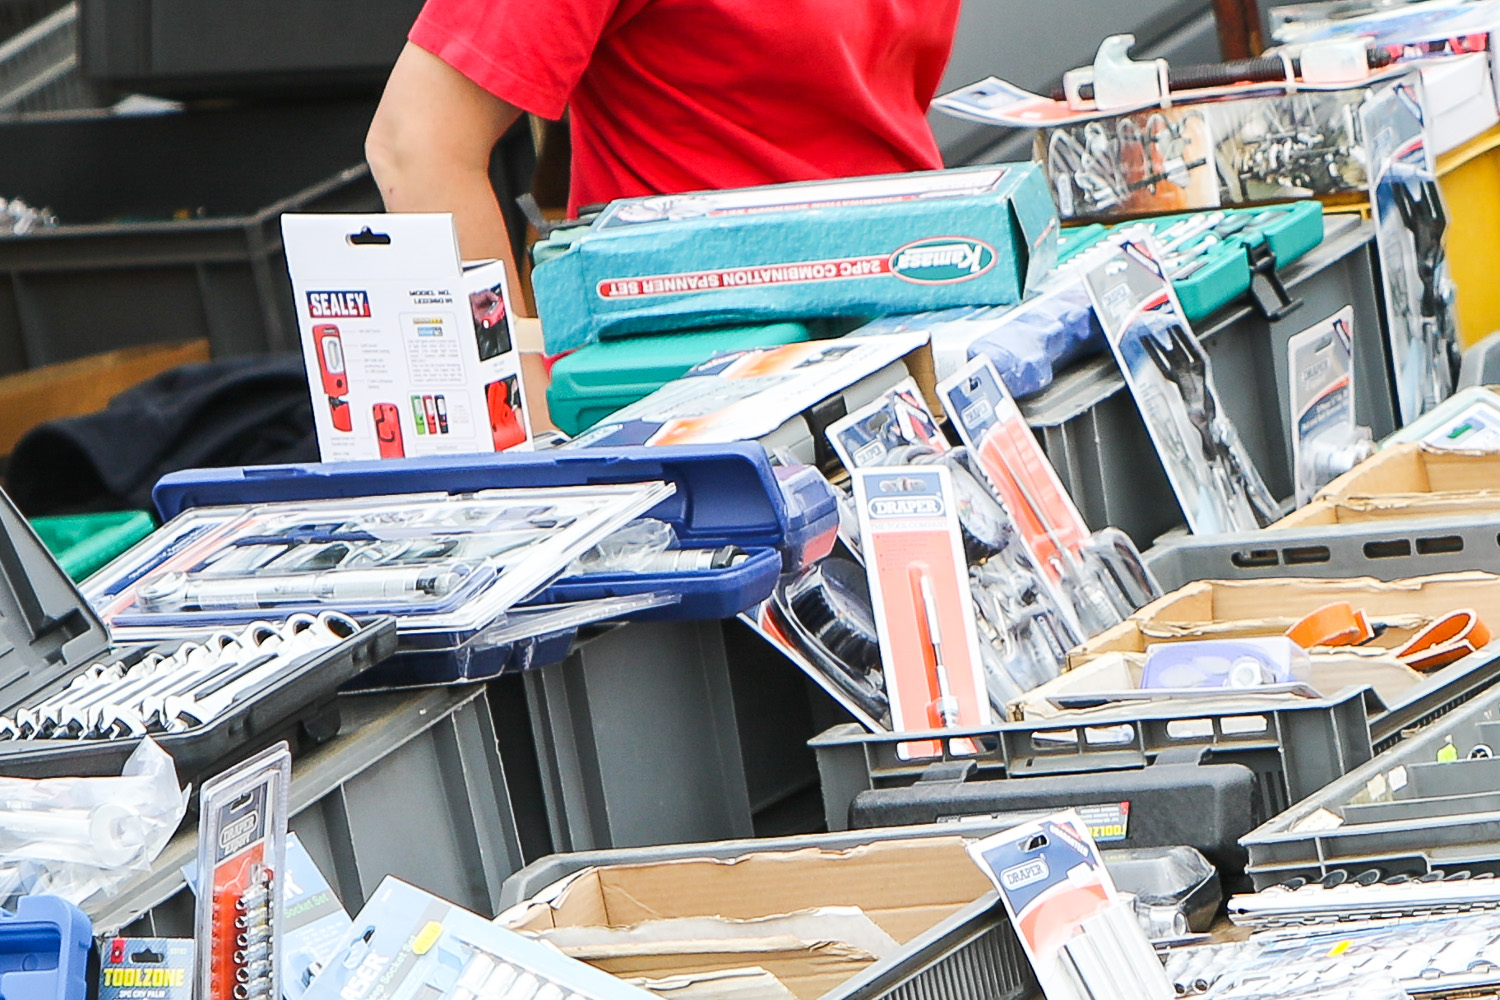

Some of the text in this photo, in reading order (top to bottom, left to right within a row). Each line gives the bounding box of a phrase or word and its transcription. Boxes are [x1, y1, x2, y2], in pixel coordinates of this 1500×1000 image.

[609, 244, 983, 296] Kamasa 24PC COMBINATION SPANNER SET
[312, 292, 366, 317] SEALEY
[876, 500, 938, 515] DRAPER
[1006, 864, 1044, 886] DRAPER
[103, 967, 186, 987] TOOLZONE
